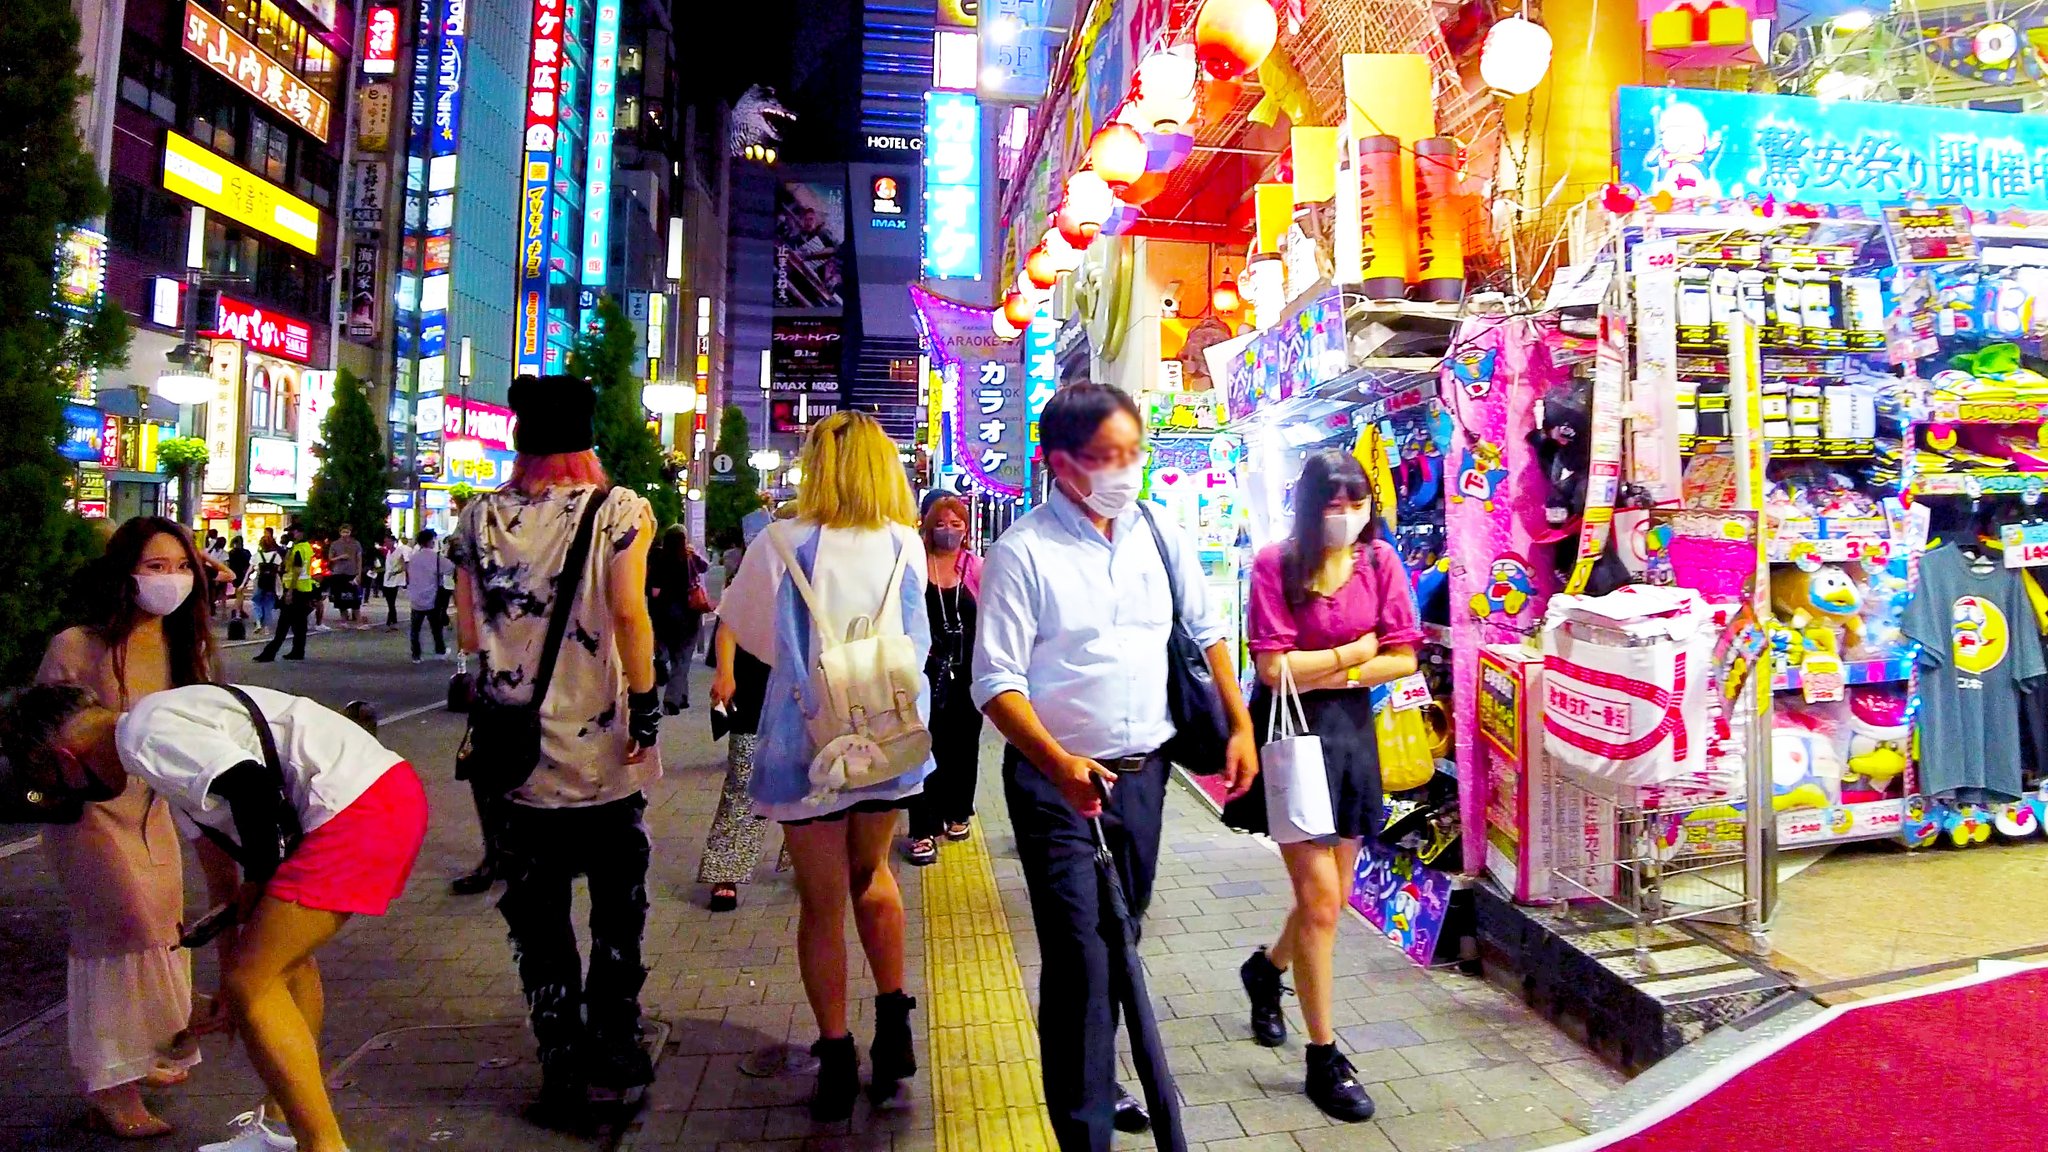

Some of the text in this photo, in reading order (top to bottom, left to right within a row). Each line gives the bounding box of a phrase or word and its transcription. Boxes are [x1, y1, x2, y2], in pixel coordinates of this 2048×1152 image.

[188, 13, 208, 46] 5F
[207, 27, 312, 126] 山内農場
[999, 45, 1032, 66] 5F
[437, 48, 459, 126] SHINJUKU
[868, 136, 908, 150] HOTEL
[932, 100, 976, 269] カラオケ
[527, 187, 546, 278] マツモトキヨシ
[872, 219, 906, 229] IMAX
[1904, 227, 1957, 239] SOCKS
[357, 247, 374, 301] 海の家へ
[526, 291, 539, 316] Shop
[773, 382, 807, 390] IMAX
[979, 361, 1009, 473] カラオケ
